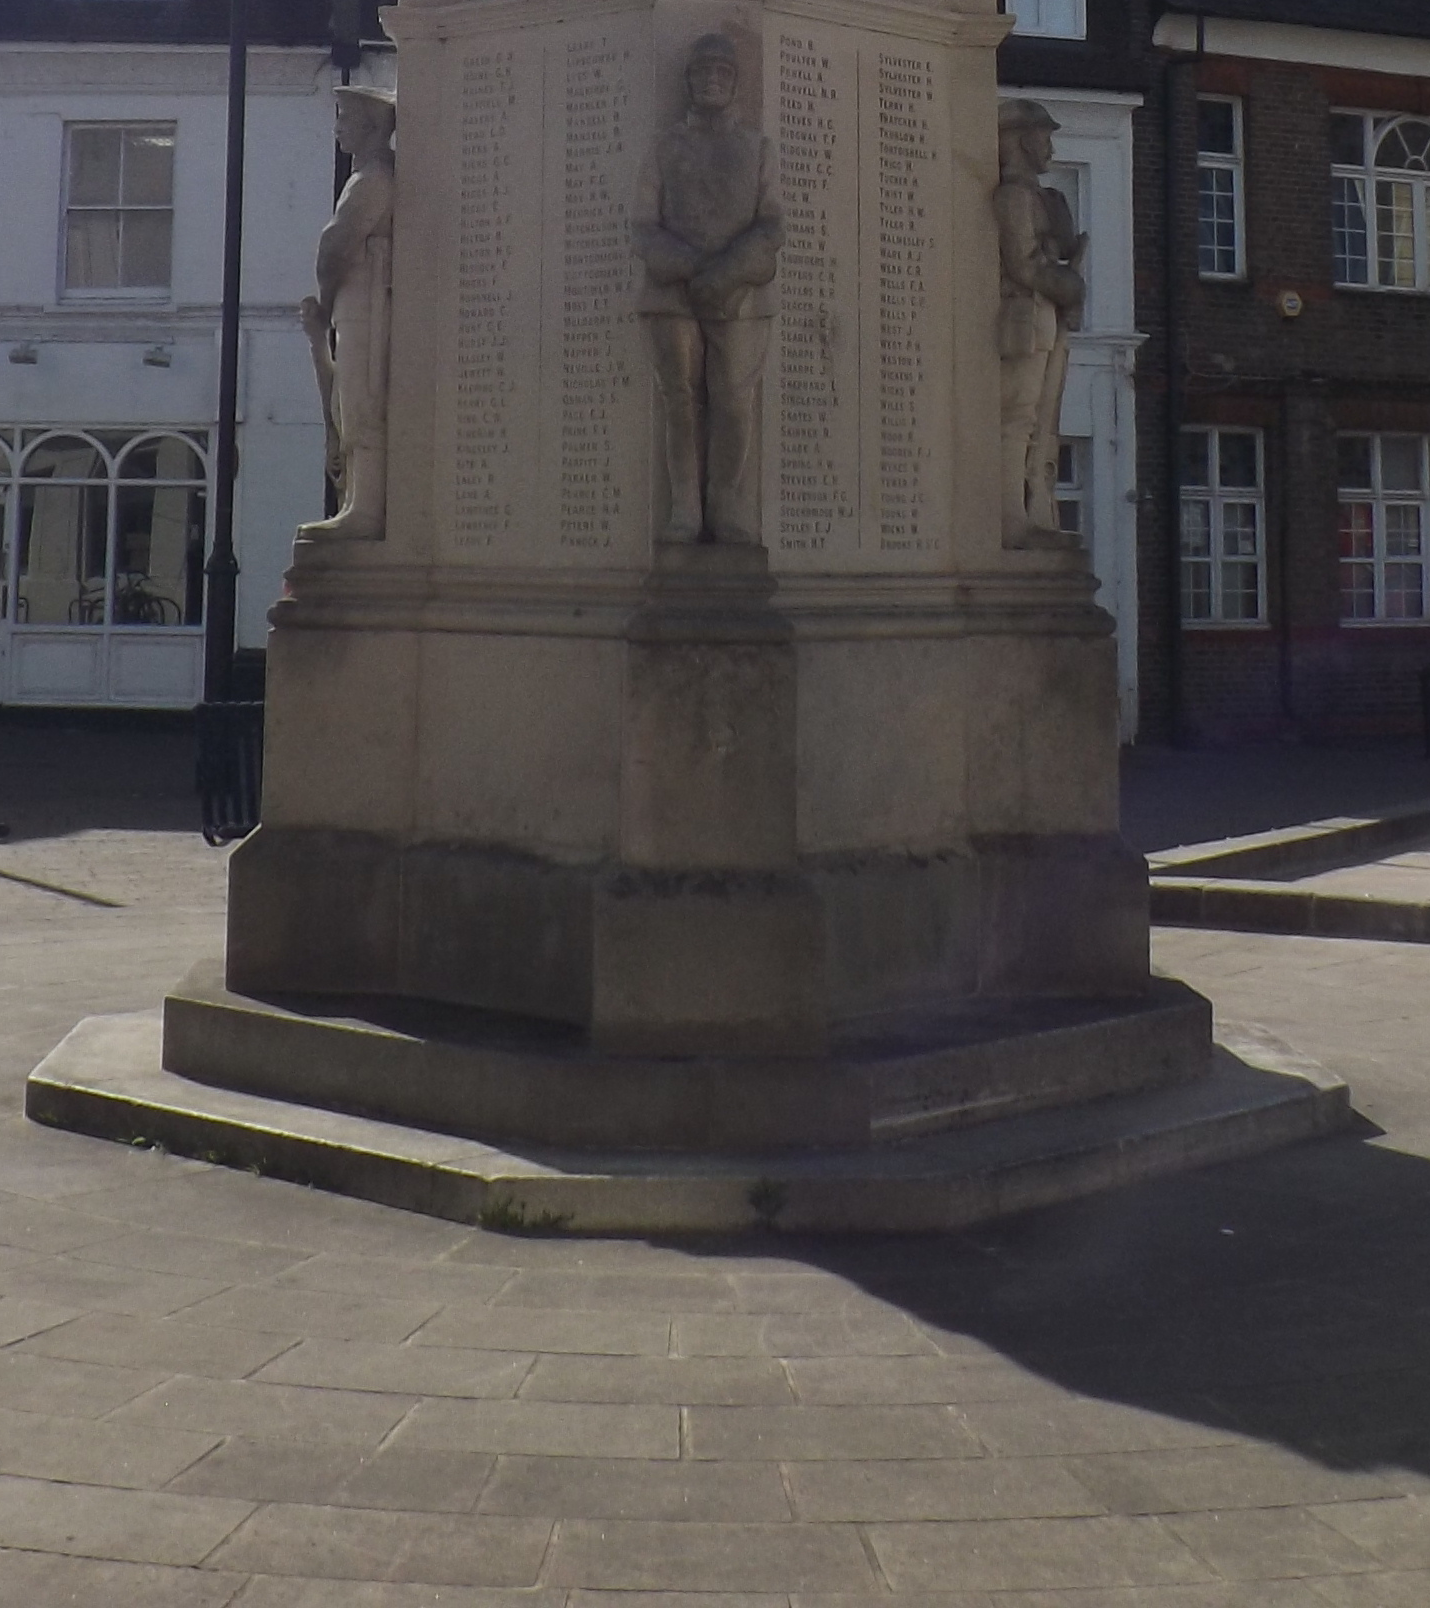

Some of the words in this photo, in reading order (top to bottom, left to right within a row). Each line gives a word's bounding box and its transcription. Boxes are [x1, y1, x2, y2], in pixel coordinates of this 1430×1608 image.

[780, 34, 802, 49] POND
[879, 53, 921, 70] SYLVESTER
[879, 68, 921, 85] SYLVESTER
[879, 82, 921, 100] SYLVESTER
